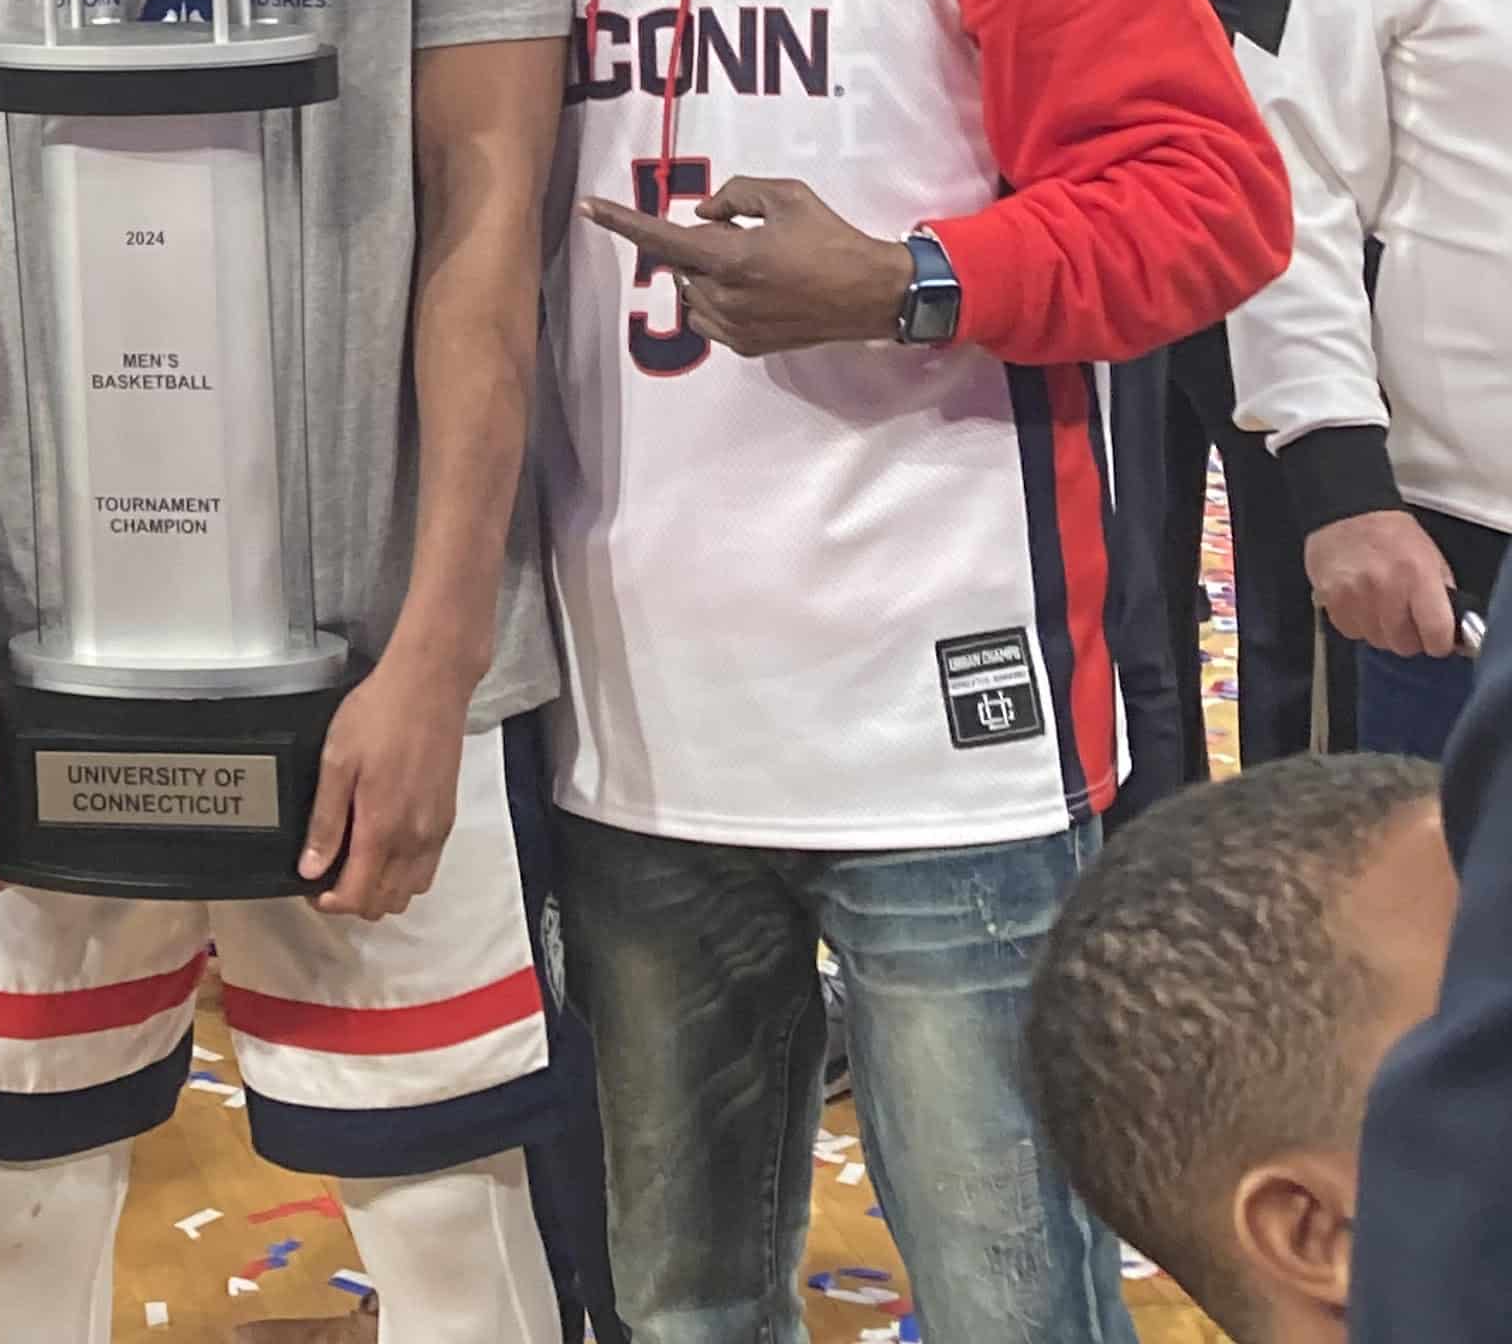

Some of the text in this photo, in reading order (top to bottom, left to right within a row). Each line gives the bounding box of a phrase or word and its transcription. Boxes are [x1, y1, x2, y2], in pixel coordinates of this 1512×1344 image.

[566, 6, 830, 105] CONN
[125, 231, 165, 246] 2024
[122, 353, 179, 369] MEN'S
[91, 375, 213, 391] BASKETBALL
[94, 497, 221, 513] TOURNAMENT
[110, 518, 208, 535] CHAMPION
[67, 764, 246, 787] UNIVERSITY OF
[72, 792, 244, 815] CONNECTICUT
